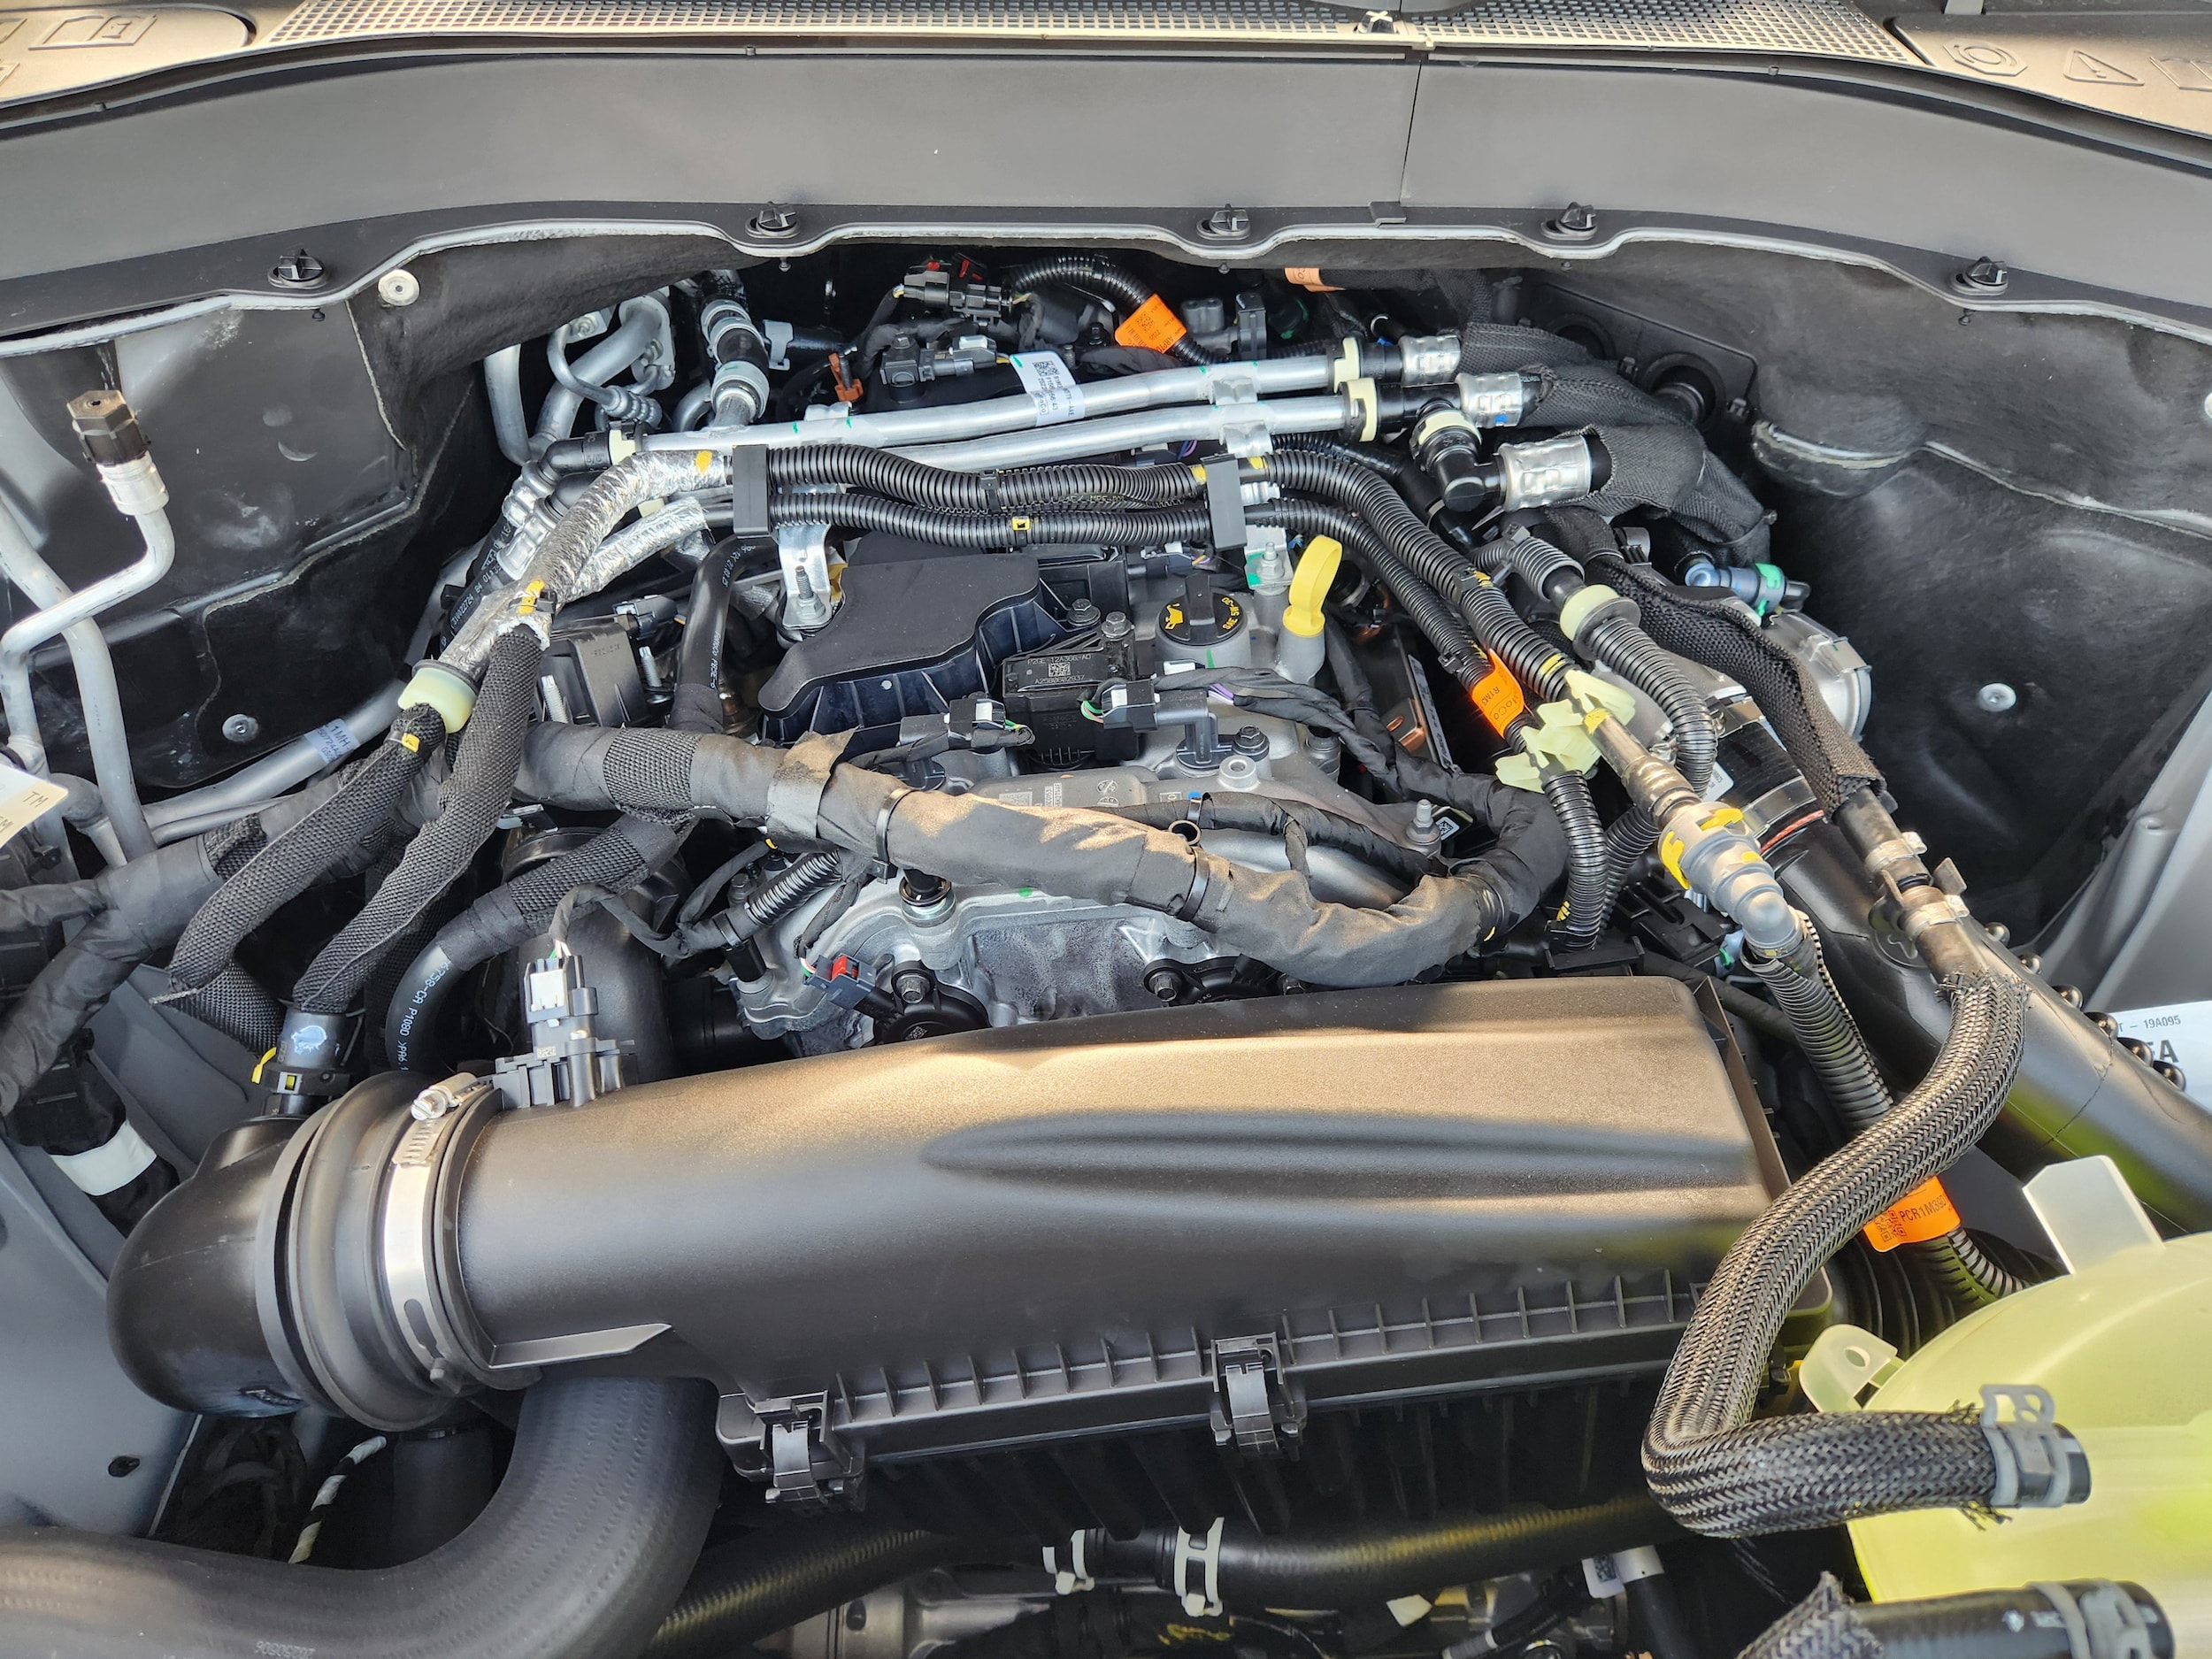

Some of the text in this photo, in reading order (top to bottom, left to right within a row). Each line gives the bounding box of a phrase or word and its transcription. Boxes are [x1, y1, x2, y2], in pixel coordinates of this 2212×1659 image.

[1222, 618, 1238, 630] SAE
[22, 792, 48, 807] TM
[2144, 1015, 2181, 1029] 19A095
